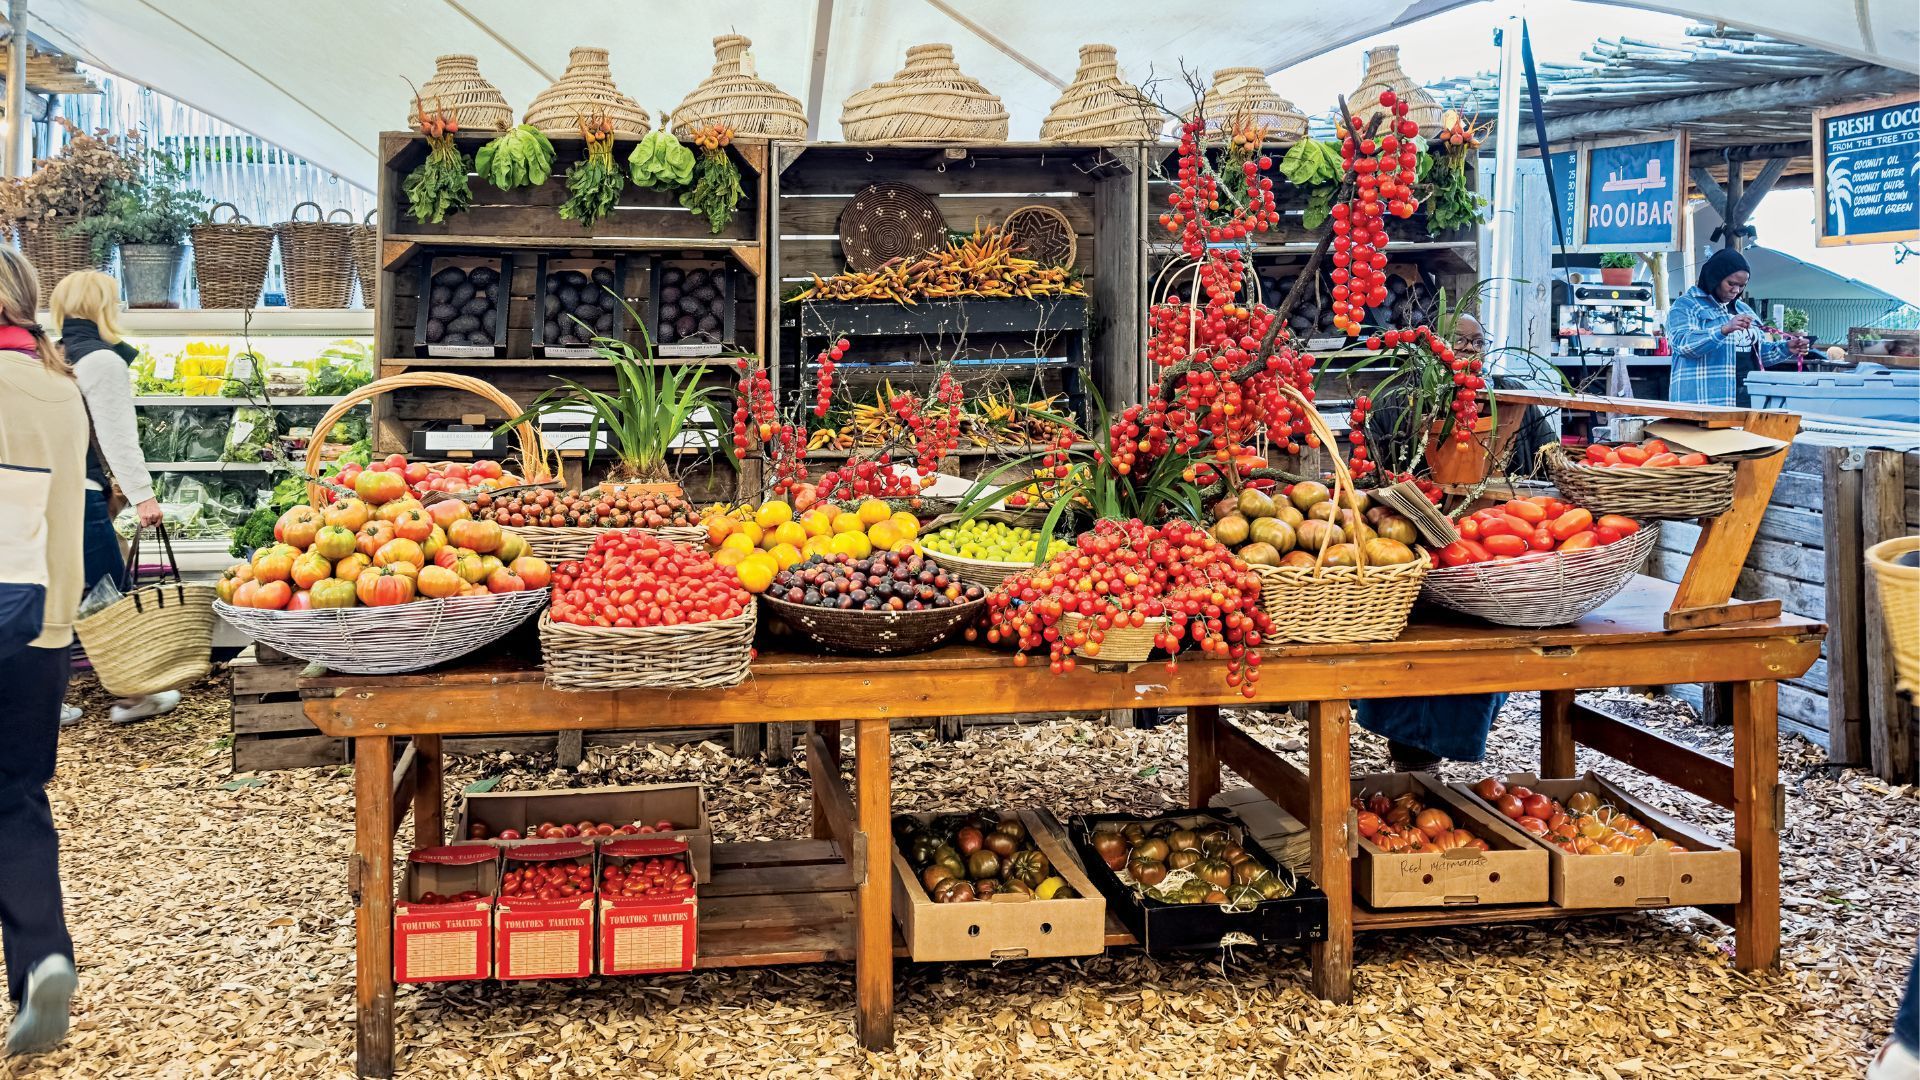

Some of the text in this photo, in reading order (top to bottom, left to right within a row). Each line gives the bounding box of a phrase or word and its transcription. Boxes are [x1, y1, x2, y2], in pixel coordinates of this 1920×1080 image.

[1828, 107, 1919, 138] FRESH COCO
[1832, 142, 1853, 152] FROM
[1857, 139, 1873, 147] THE
[1876, 134, 1898, 144] TREE
[1901, 132, 1914, 140] TO
[1853, 155, 1900, 170] COCONUT OIL
[1851, 168, 1905, 183] COCONUT WATER
[1854, 180, 1905, 194] COCONUT CHIPS
[1853, 190, 1909, 206] COCONUT BROWN
[1589, 201, 1673, 229] ROOIBAR
[1853, 202, 1913, 217] COCONUT GREEN
[1400, 858, 1422, 877] Red
[402, 918, 483, 931] TOMATOES TAMATIES
[505, 917, 585, 929] TOMATOES TAMATIES
[610, 912, 689, 925] TOMATOES TAMATIES
